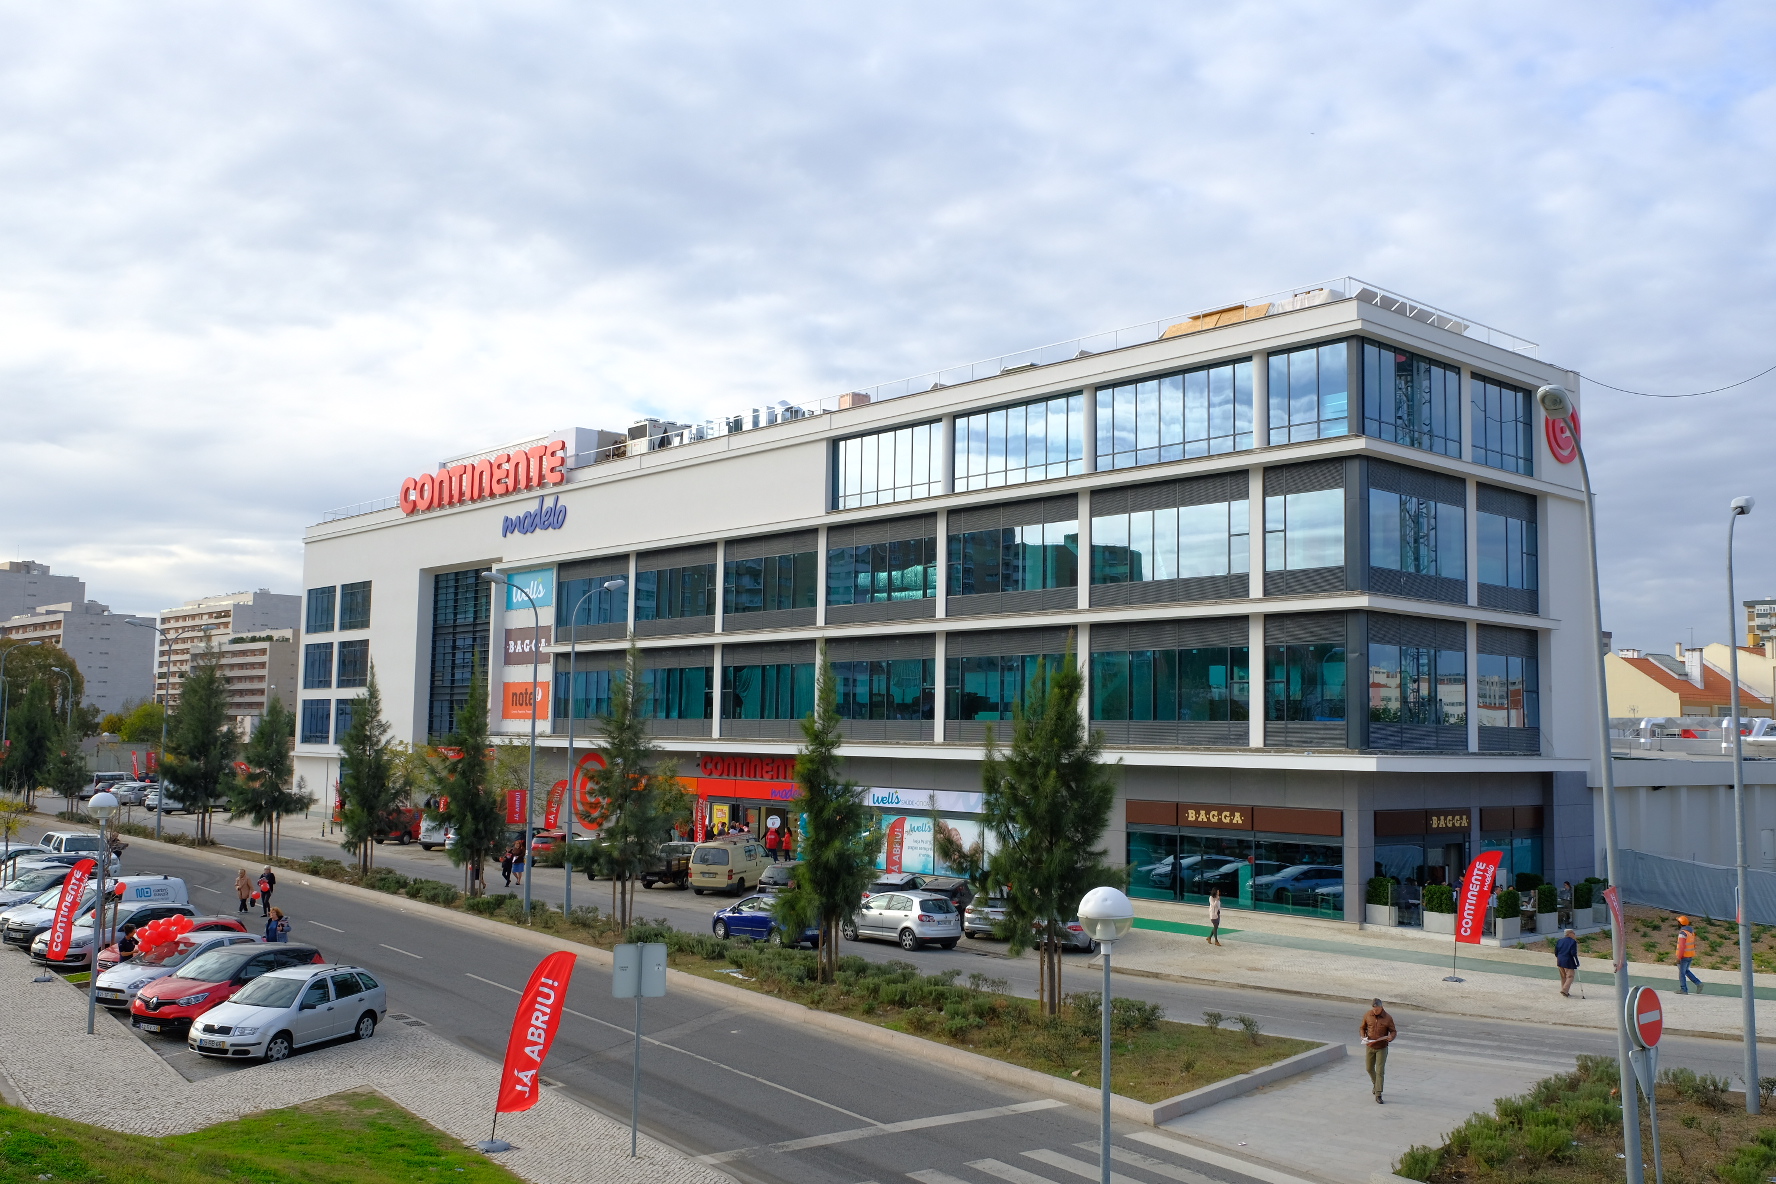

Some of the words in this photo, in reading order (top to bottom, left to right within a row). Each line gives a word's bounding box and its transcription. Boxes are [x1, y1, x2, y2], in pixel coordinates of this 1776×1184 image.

[399, 439, 566, 515] CONTINENTE
[501, 494, 567, 538] modelo
[700, 756, 797, 780] CONTINENT
[872, 790, 901, 805] wells
[1460, 861, 1487, 936] CONTINENTE
[1483, 864, 1495, 891] modelo
[53, 869, 82, 951] CONTINENTE
[524, 977, 559, 1062] ABRIU!
[514, 1067, 537, 1098] JÁ
